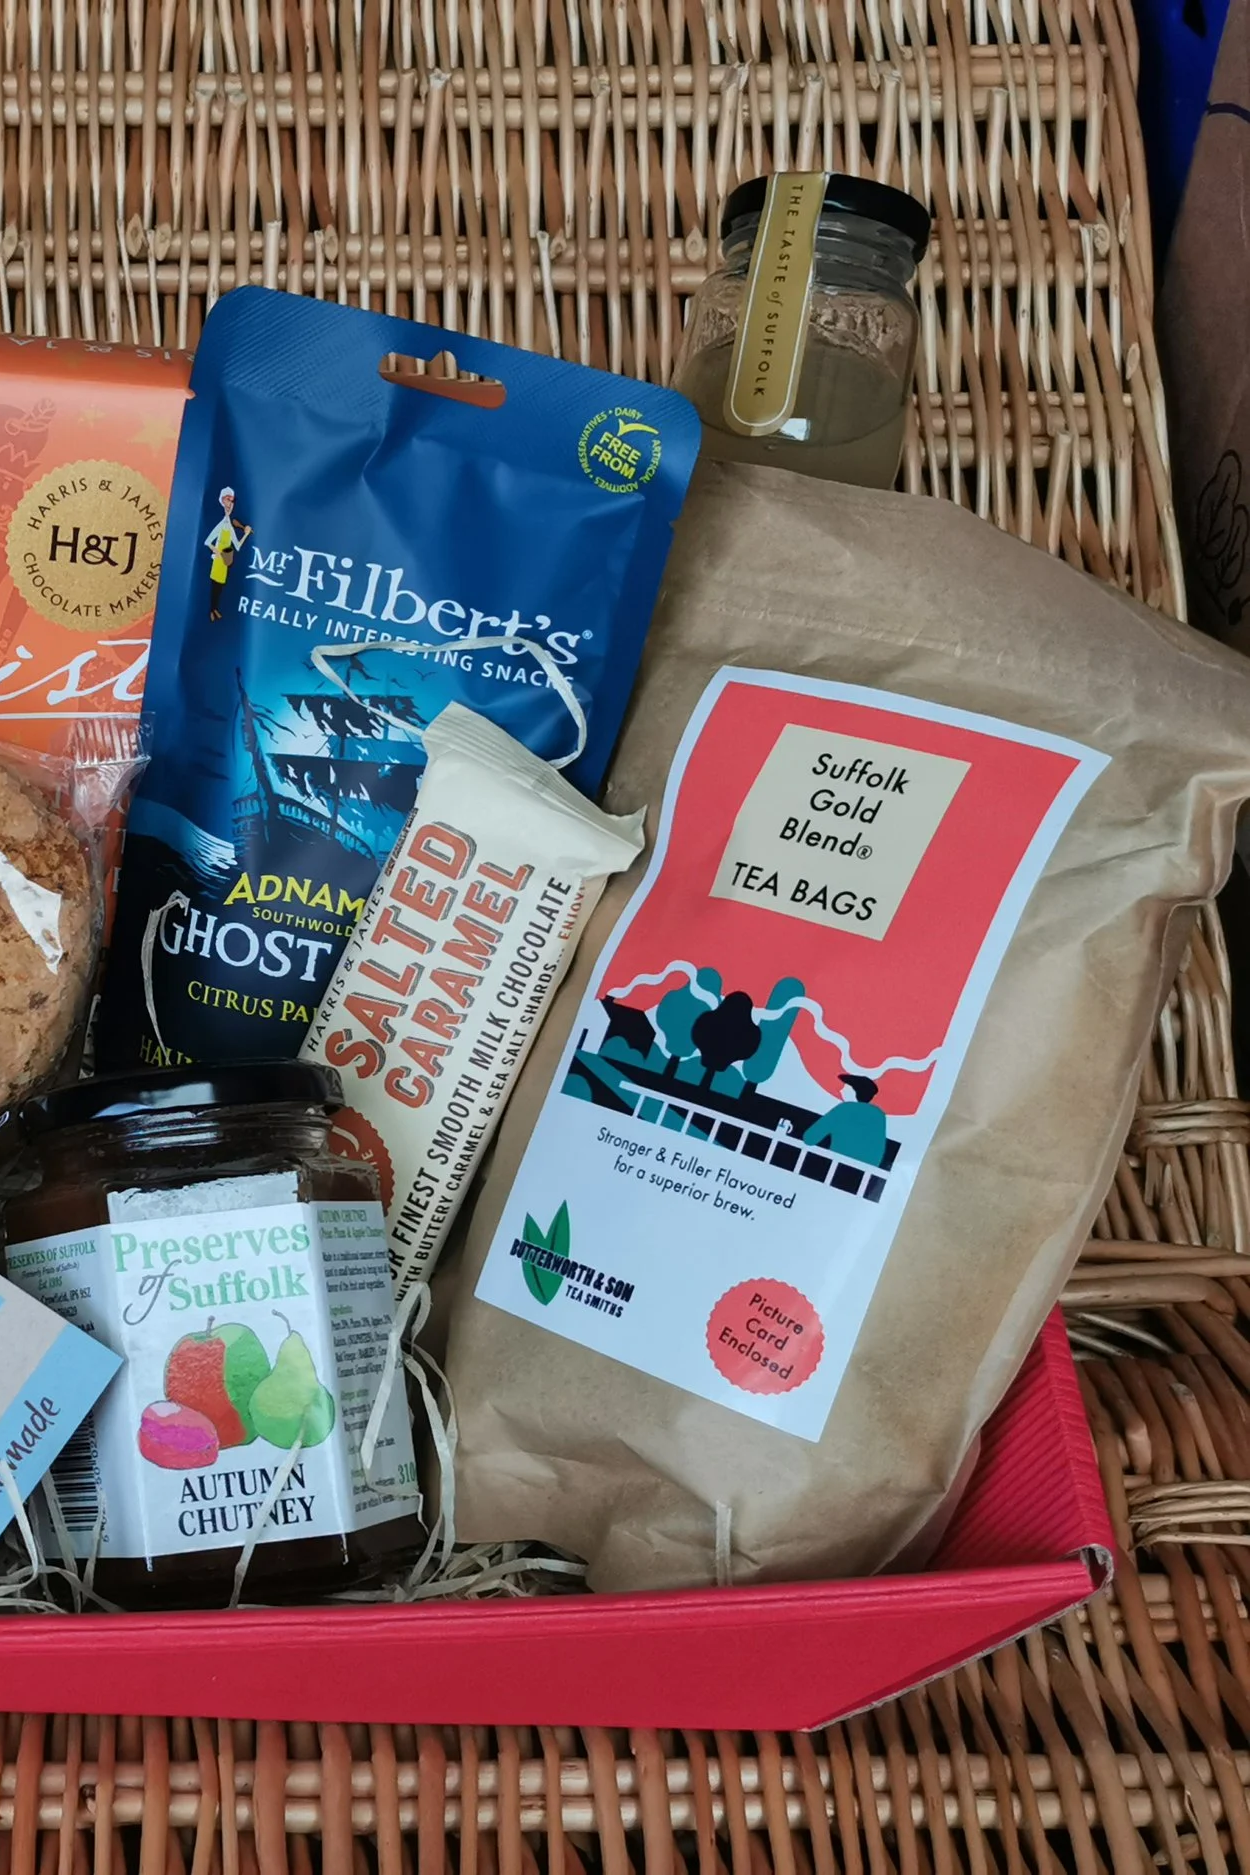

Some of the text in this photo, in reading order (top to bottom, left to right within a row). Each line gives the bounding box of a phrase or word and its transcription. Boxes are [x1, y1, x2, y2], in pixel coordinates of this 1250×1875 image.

[786, 184, 804, 218] THE
[773, 230, 796, 283] TASTE
[753, 311, 780, 397] SUFFOLK
[590, 444, 636, 480] FROM
[599, 431, 642, 466] FREE
[27, 477, 164, 542] HARRIS & JAMES
[49, 524, 139, 576] H&J
[23, 552, 162, 618] CHOCOLATE MAKERS
[237, 595, 319, 631] REALLY
[811, 752, 911, 794] Suffolk
[809, 788, 883, 824] Gold
[731, 861, 877, 921] TEA BAGS
[158, 889, 333, 983] GHOST
[252, 906, 355, 937] SOUTHWOLD
[307, 976, 346, 1053] HARRIS
[358, 884, 385, 951] JAMES
[323, 820, 477, 1080] SALTED
[187, 980, 273, 1018] CITRUS
[382, 860, 535, 1112] CARAMEL
[391, 1166, 440, 1247] FINEST
[426, 1073, 483, 1166] SMOOTH
[468, 1011, 511, 1071] MILK
[496, 876, 572, 1009] CHOCOLATE
[414, 1196, 453, 1260] BUTTERY
[446, 1122, 487, 1191] CARAMEL
[486, 1072, 509, 1100] SEA
[502, 1030, 528, 1068] SALT
[596, 1126, 797, 1210] Stronger & Fuller Flavoured
[613, 1154, 756, 1221] for a superior brew.
[111, 1222, 311, 1274] Preserves
[509, 1238, 636, 1304] BUTTERWORTH & SON
[122, 1258, 311, 1328] of Suffolk
[565, 1284, 624, 1319] TEA SMITHS
[748, 1293, 804, 1336] Picture
[718, 1326, 794, 1381] Enclosed
[744, 1317, 789, 1352] Card
[179, 1463, 307, 1504] AUTUMN
[177, 1496, 316, 1538] CHUTNEY
